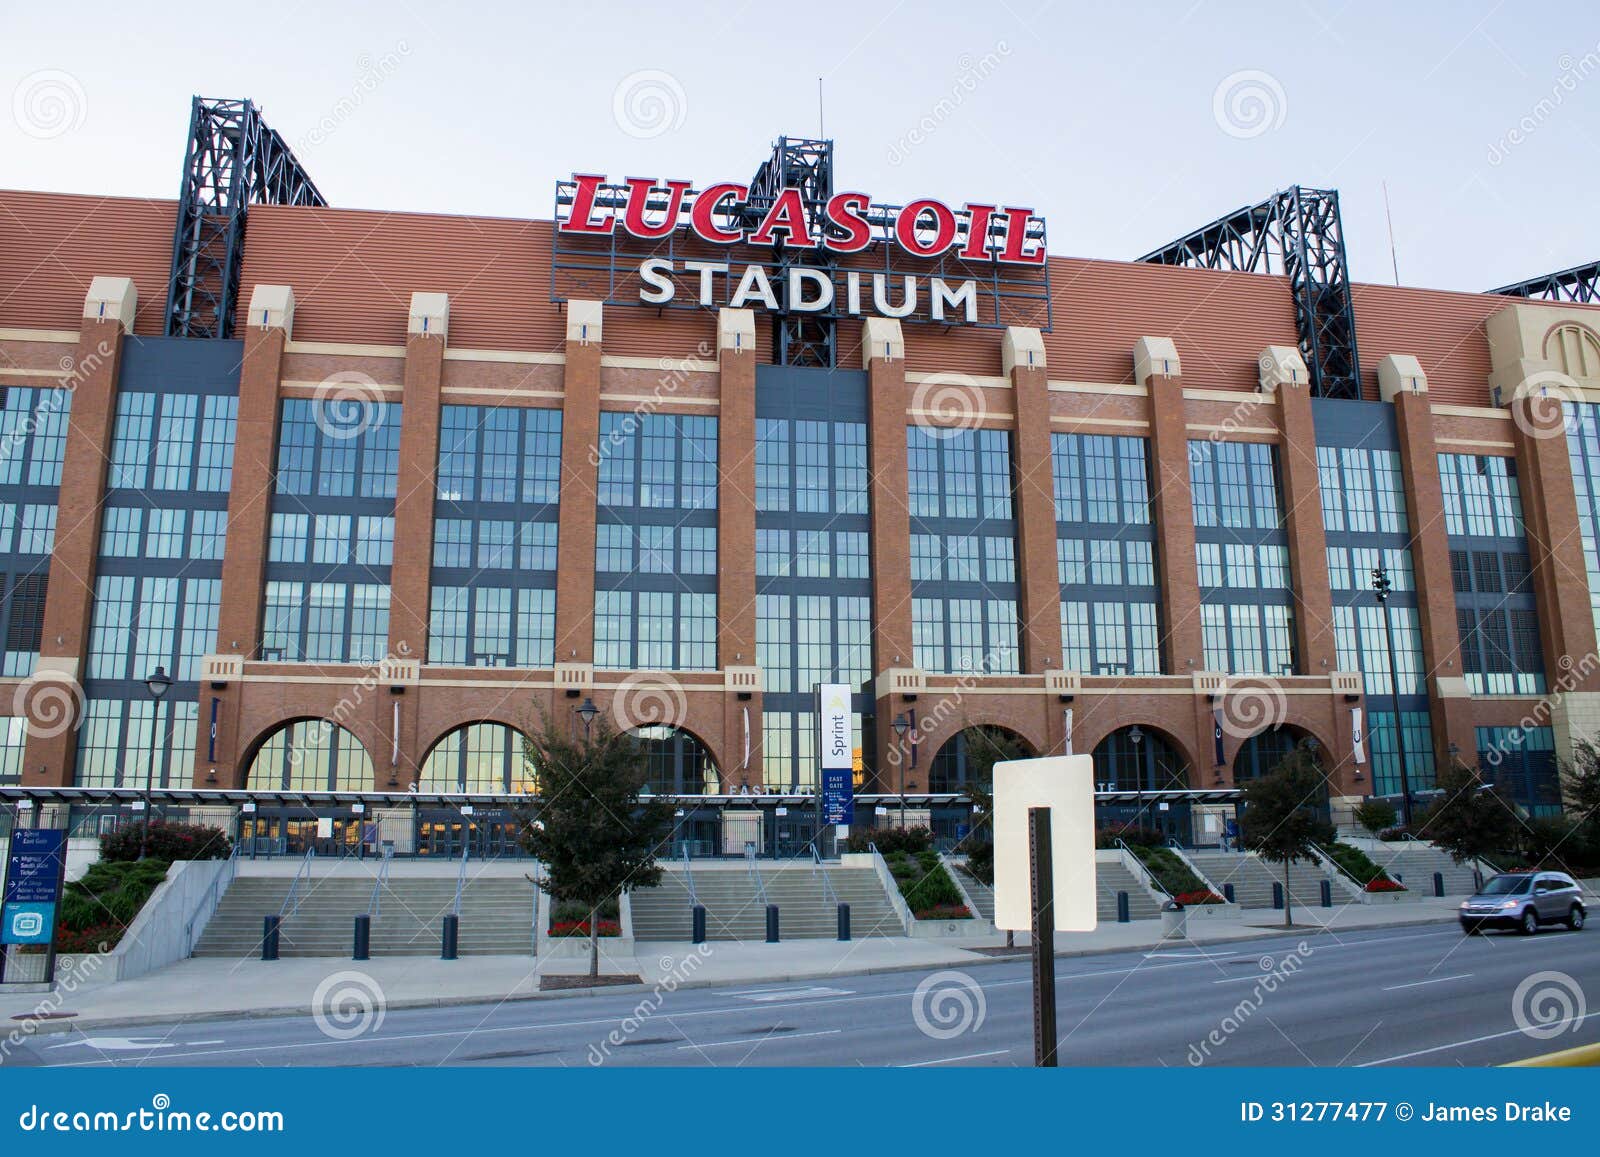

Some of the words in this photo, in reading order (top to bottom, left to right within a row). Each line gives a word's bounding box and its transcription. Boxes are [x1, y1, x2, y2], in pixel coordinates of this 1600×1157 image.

[558, 172, 873, 254] LUCAS
[894, 197, 1047, 266] OIL
[639, 258, 979, 323] STADIUM
[831, 715, 847, 757] Sprint
[729, 785, 771, 796] EAST
[780, 785, 815, 796] GAT
